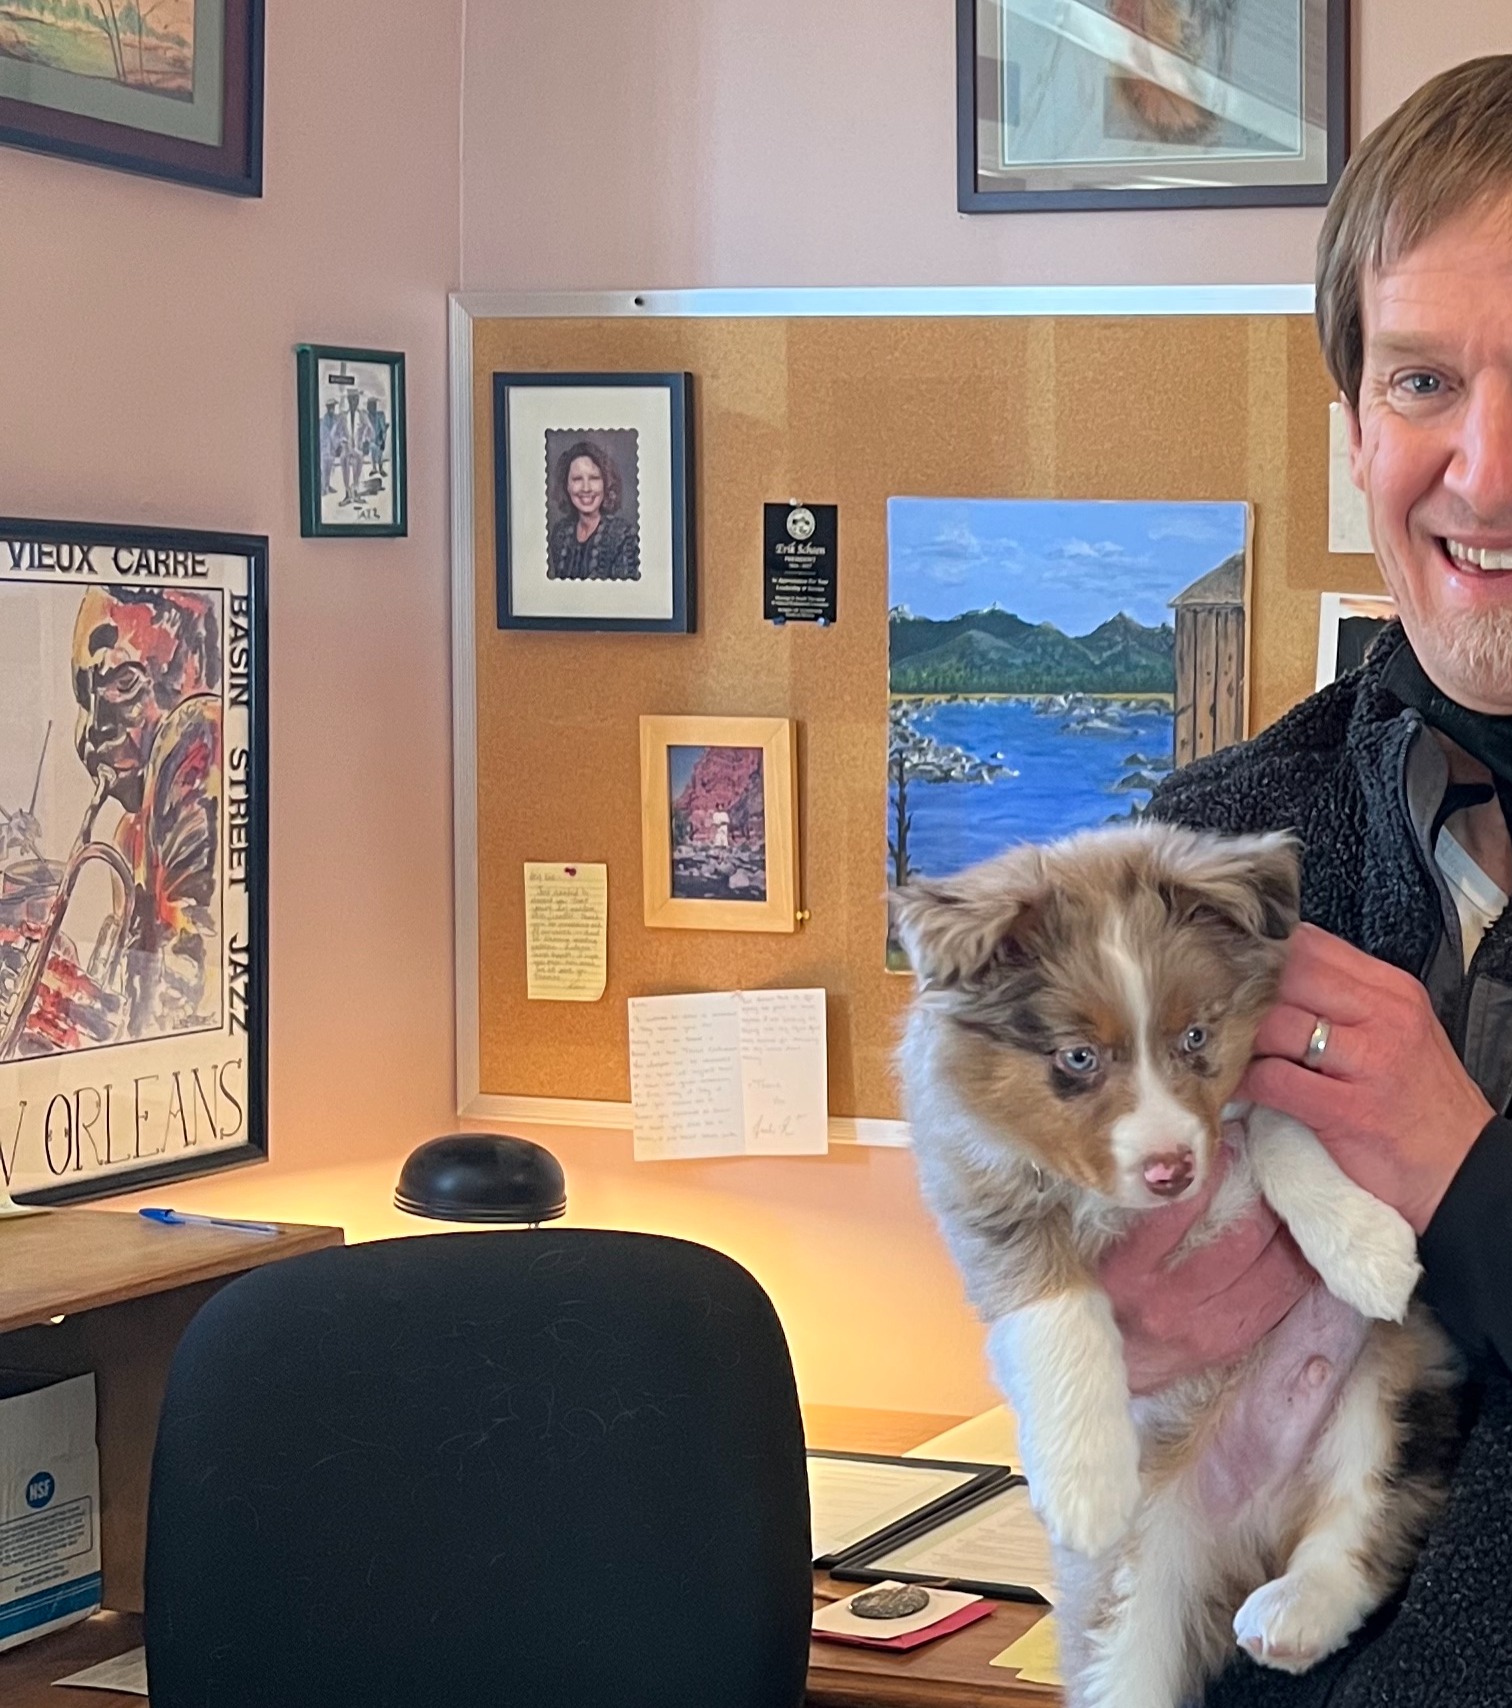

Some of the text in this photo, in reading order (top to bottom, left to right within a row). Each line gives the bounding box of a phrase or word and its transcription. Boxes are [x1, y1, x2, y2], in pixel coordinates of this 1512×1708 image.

[9, 541, 210, 578] VIEUX CARRE
[228, 590, 249, 1037] BASIN STREET JAZZ
[45, 1058, 244, 1176] ORLEANS
